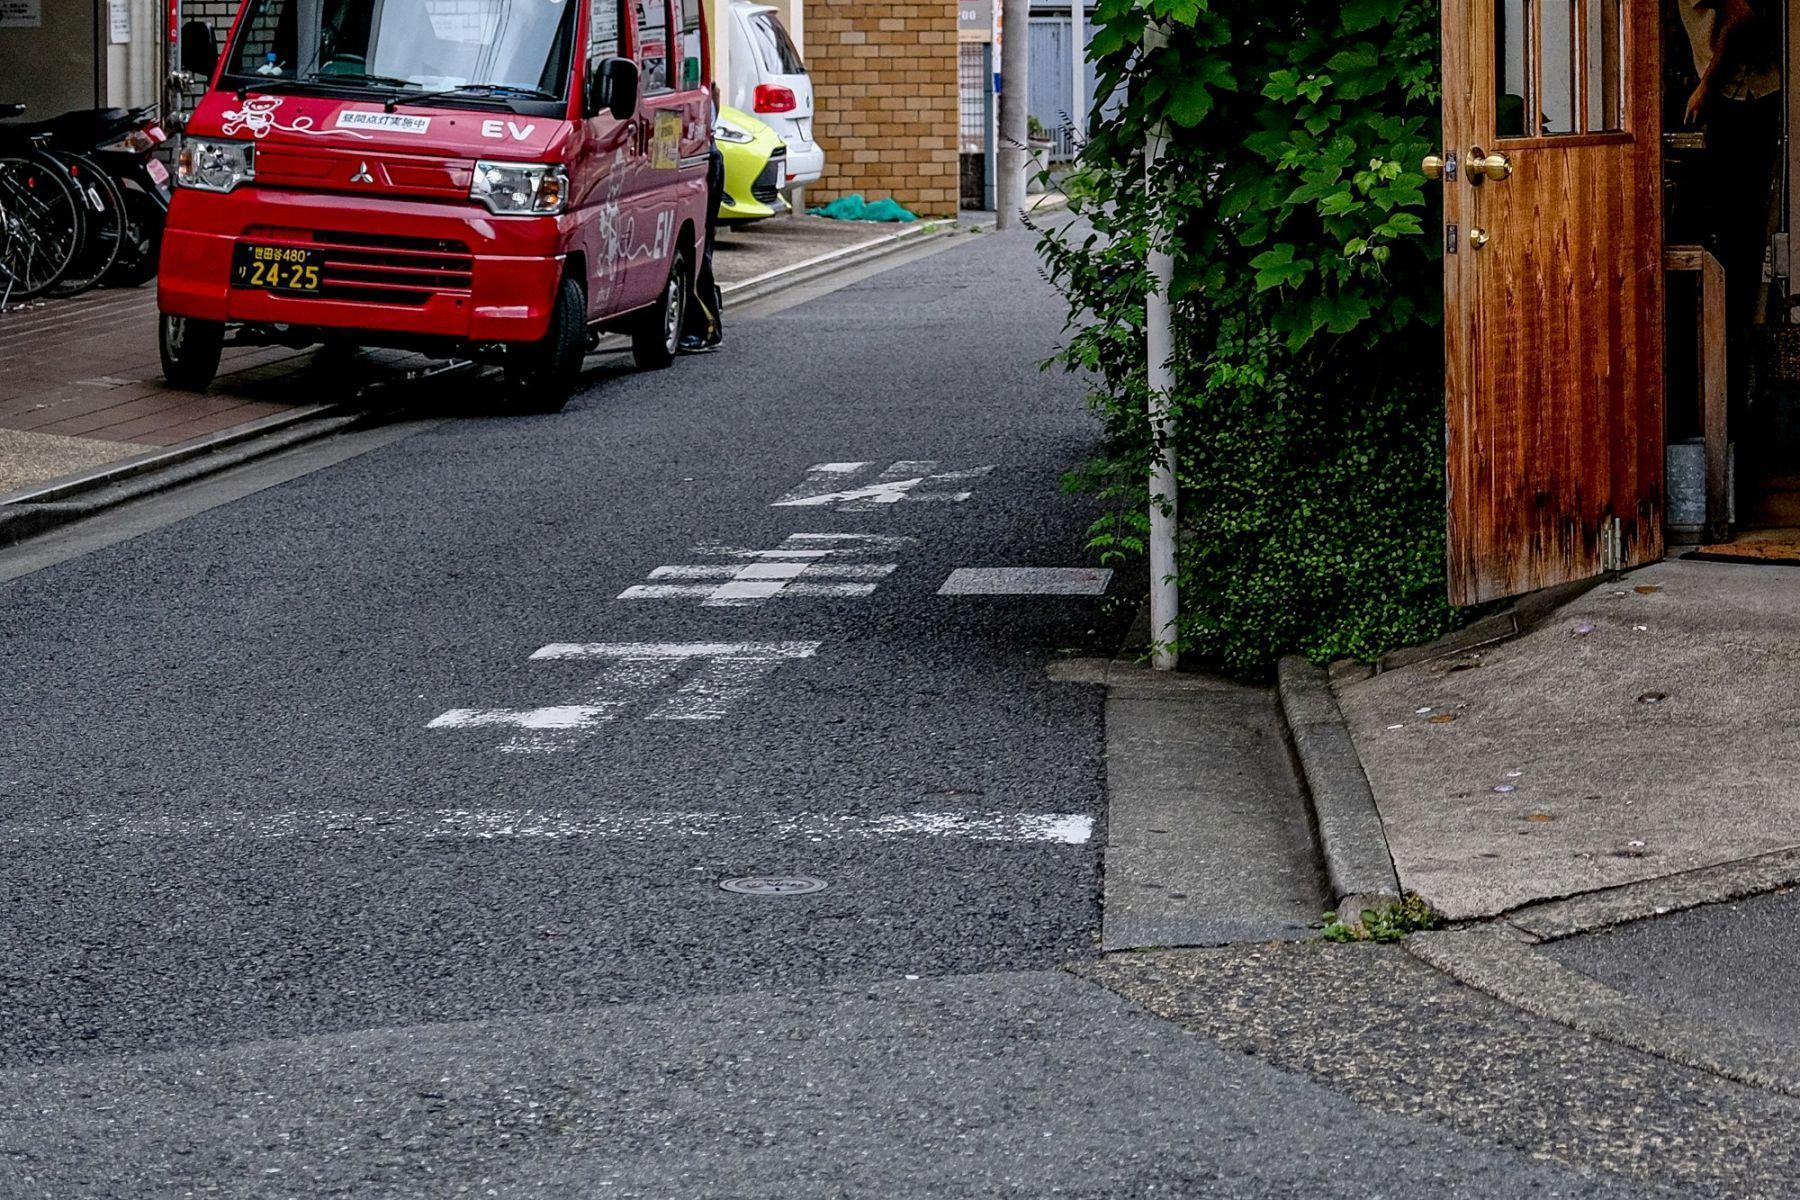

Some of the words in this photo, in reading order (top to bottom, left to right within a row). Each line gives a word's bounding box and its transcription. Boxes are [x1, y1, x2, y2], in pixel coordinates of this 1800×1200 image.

[342, 112, 426, 129] 昼間点灯実施中
[481, 118, 536, 141] EV
[653, 209, 675, 259] EV
[250, 261, 319, 289] 24-25
